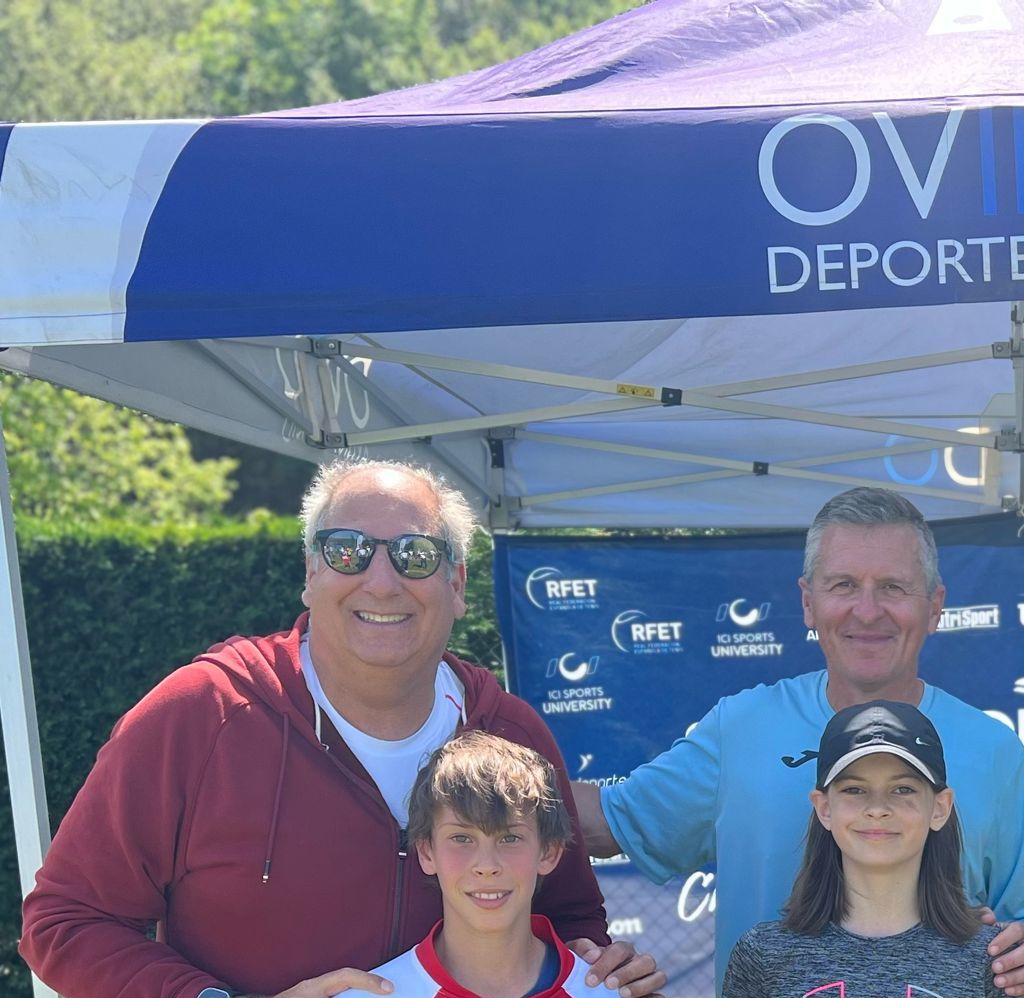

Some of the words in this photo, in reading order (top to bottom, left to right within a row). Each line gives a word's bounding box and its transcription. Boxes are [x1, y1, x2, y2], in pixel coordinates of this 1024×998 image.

[545, 579, 598, 598] RFET
[631, 621, 682, 641] RFET
[716, 633, 731, 644] ICI
[732, 632, 775, 643] SPORTS
[710, 643, 783, 657] UNIVERSITY
[547, 690, 561, 700] ICI
[562, 686, 604, 699] SPORTS
[542, 698, 612, 714] UNIVERSITY
